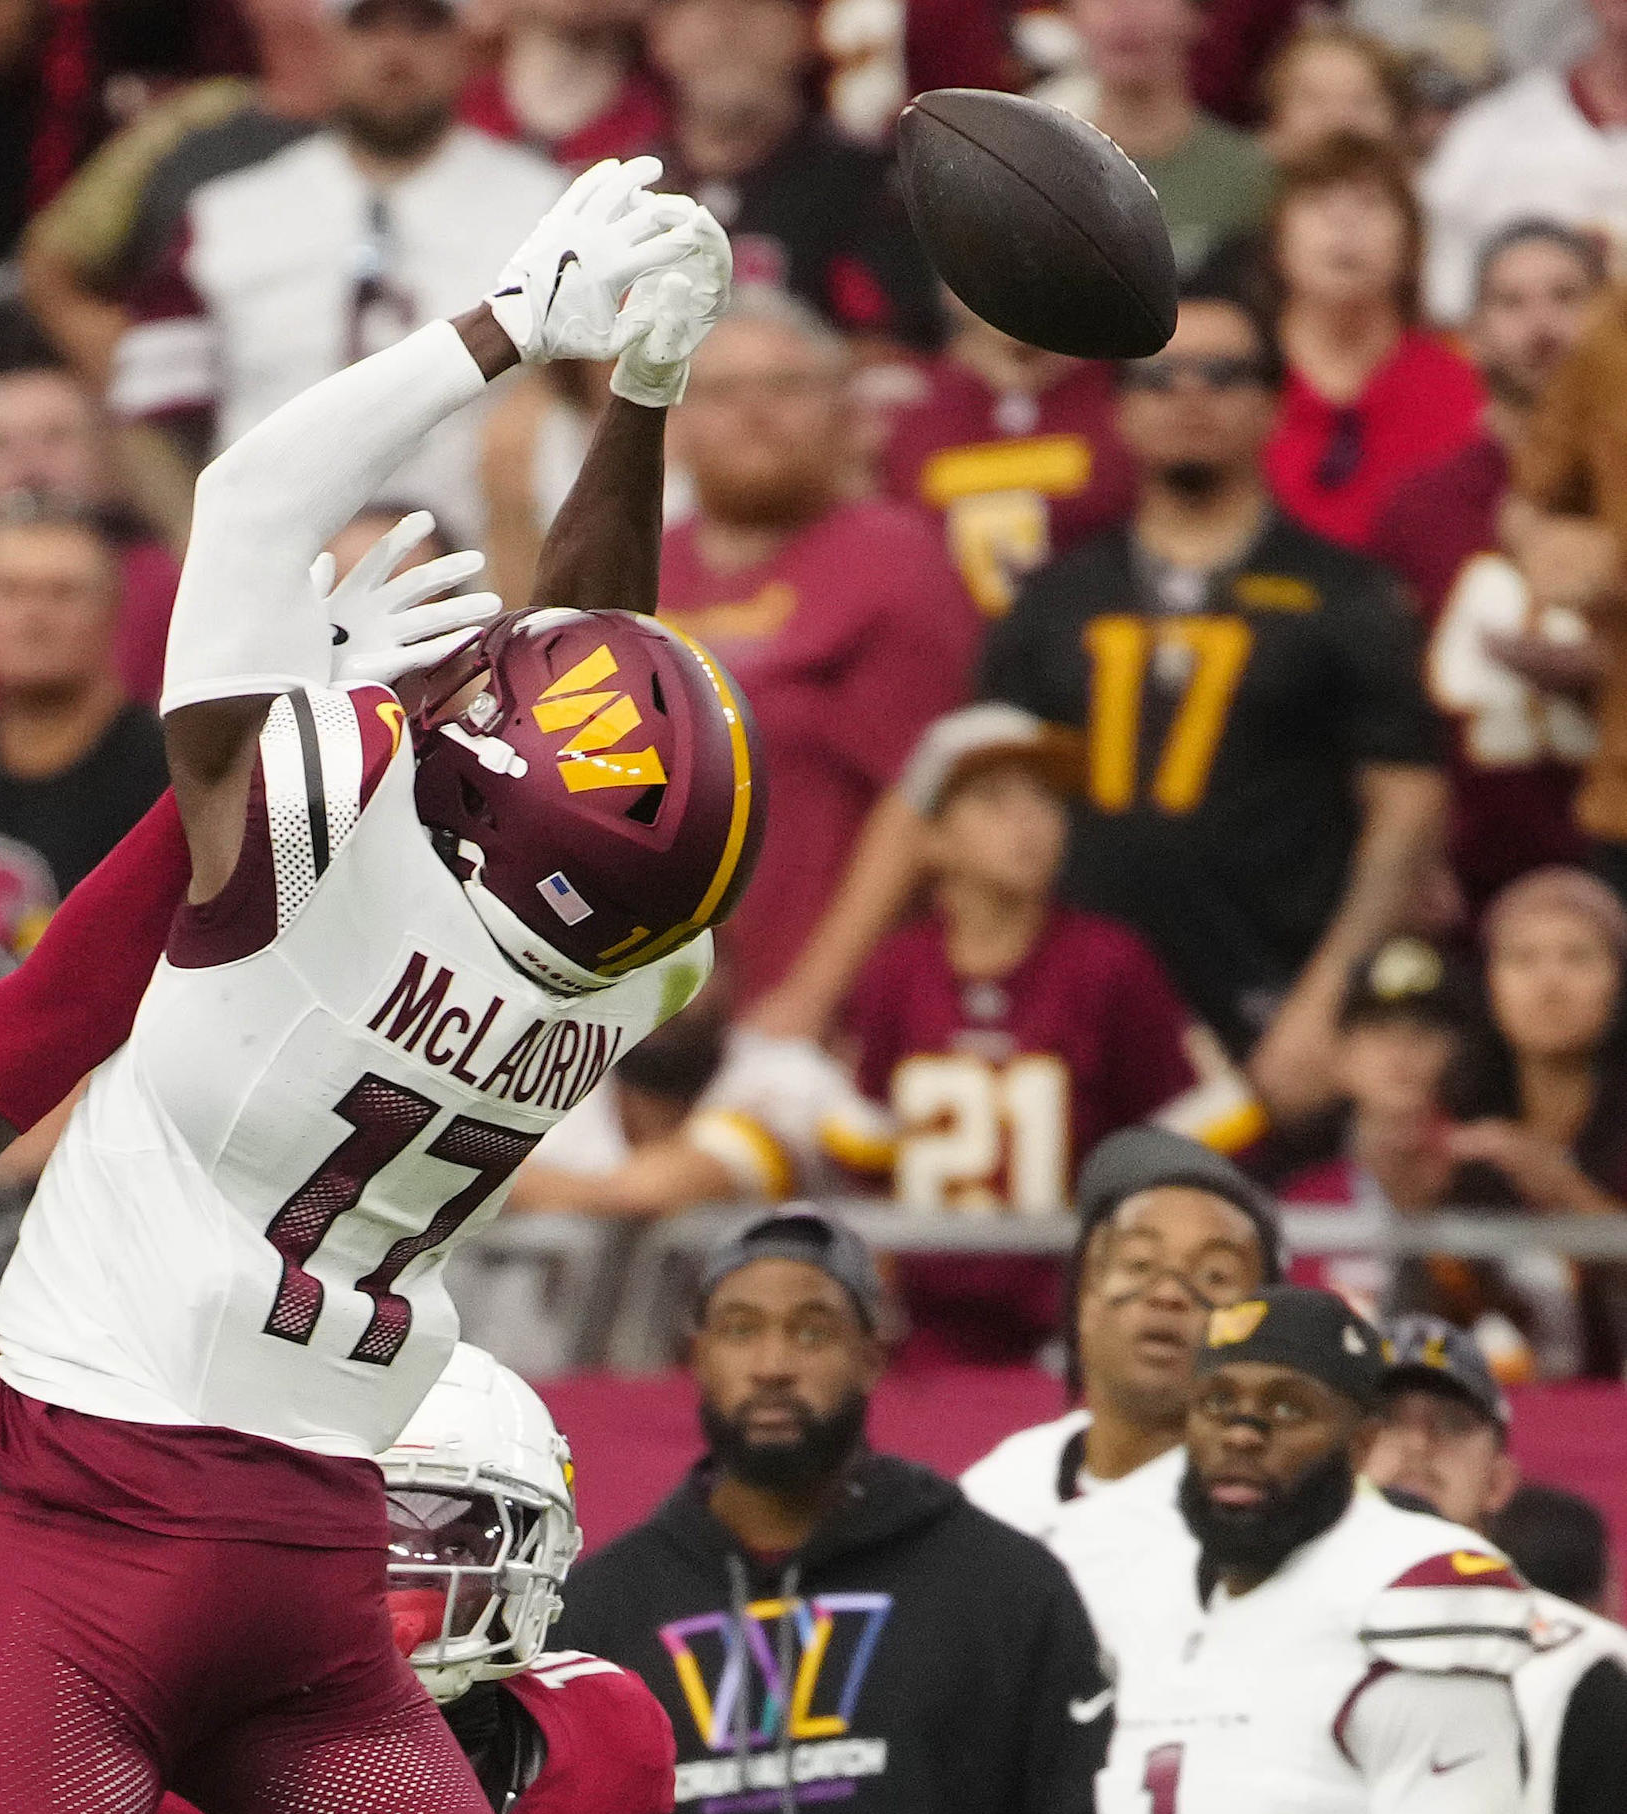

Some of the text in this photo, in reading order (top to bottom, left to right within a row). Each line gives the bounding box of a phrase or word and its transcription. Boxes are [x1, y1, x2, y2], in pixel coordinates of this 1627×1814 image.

[1082, 612, 1255, 815] 17
[366, 950, 623, 1111] McLAURIN
[889, 1052, 1074, 1210] 21
[261, 1071, 546, 1377] 17
